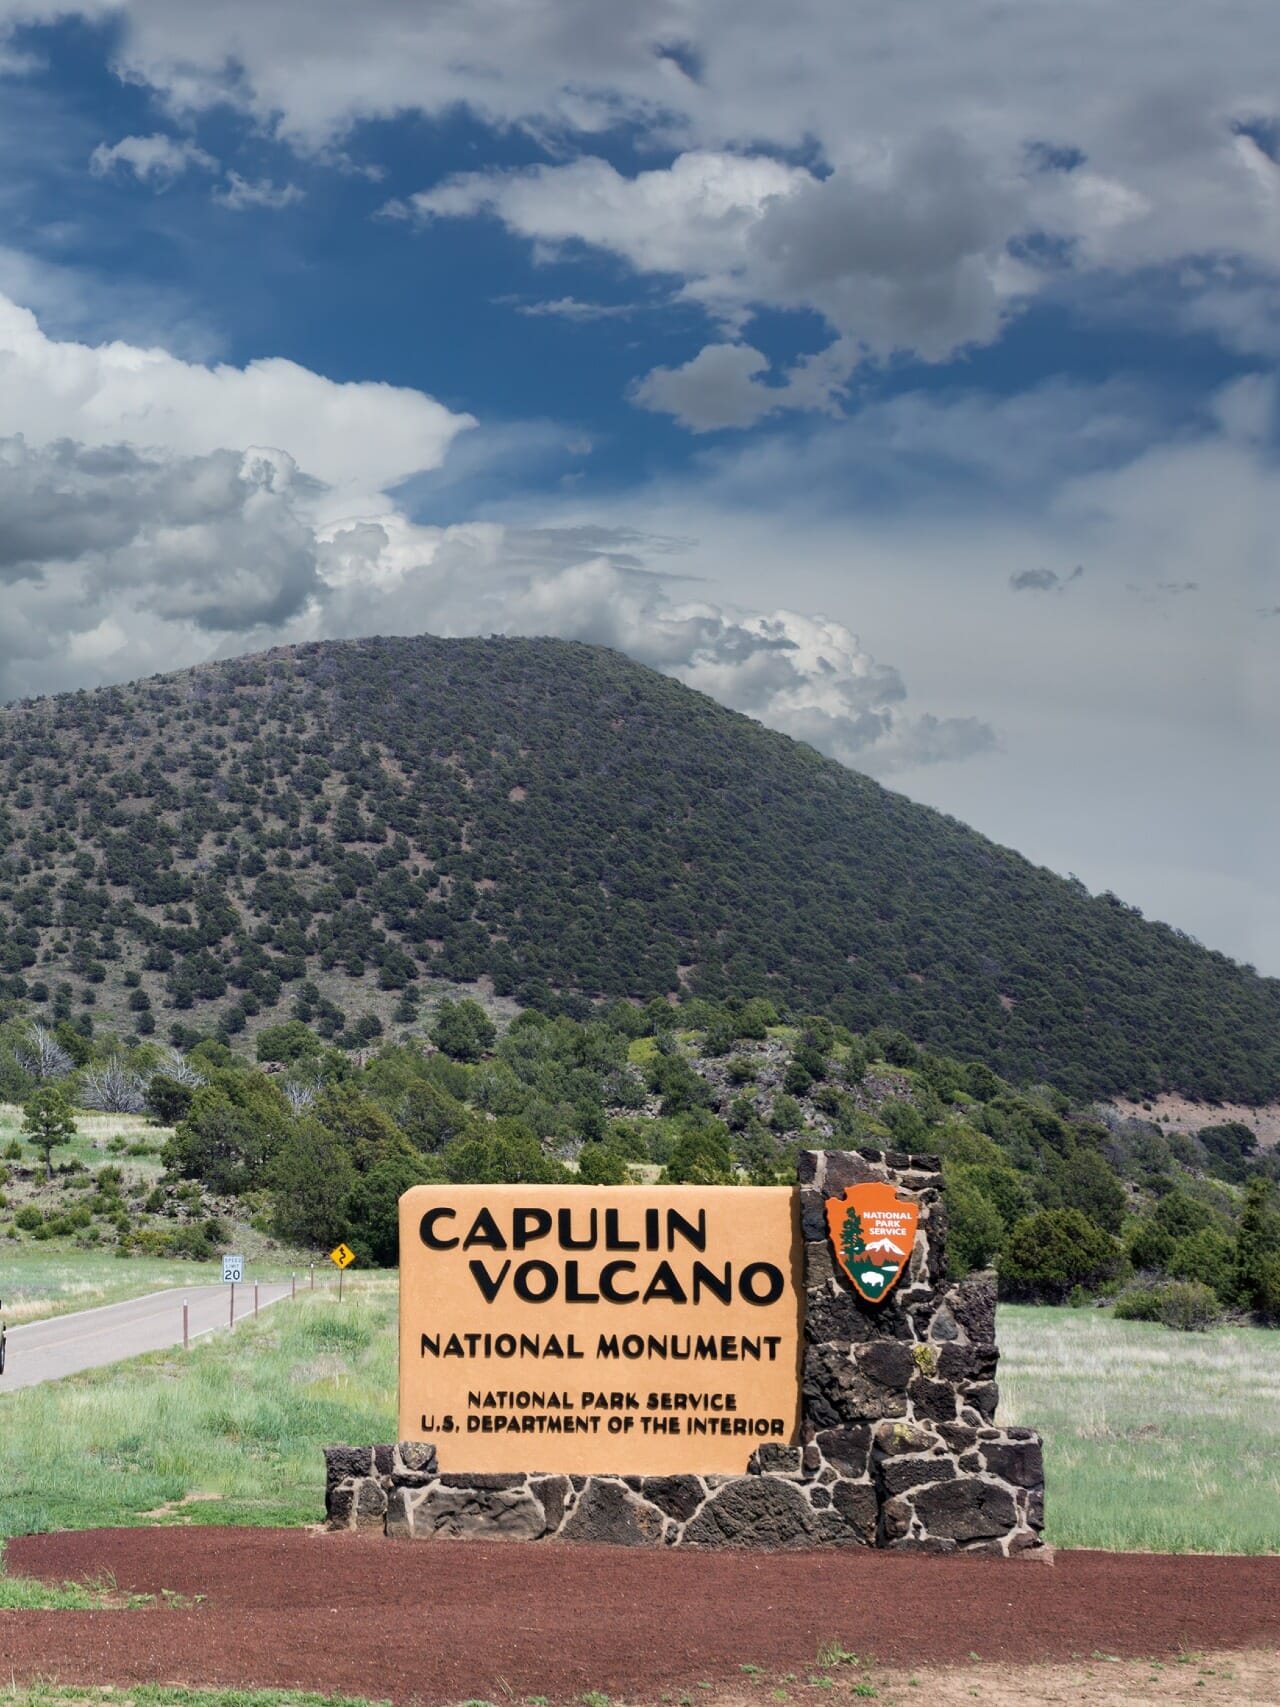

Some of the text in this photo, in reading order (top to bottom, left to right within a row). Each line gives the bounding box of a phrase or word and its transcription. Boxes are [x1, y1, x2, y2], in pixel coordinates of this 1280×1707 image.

[419, 1207, 706, 1252] CAPULIN
[225, 1269, 240, 1280] 20
[469, 1260, 785, 1306] VOLCANO
[420, 1333, 782, 1361] NATIONAL MONUMENT
[468, 1390, 737, 1412] NATIONAL PARK SERVICE
[421, 1414, 785, 1437] U.S. DEPARTMENT OF THE INTERIOR
